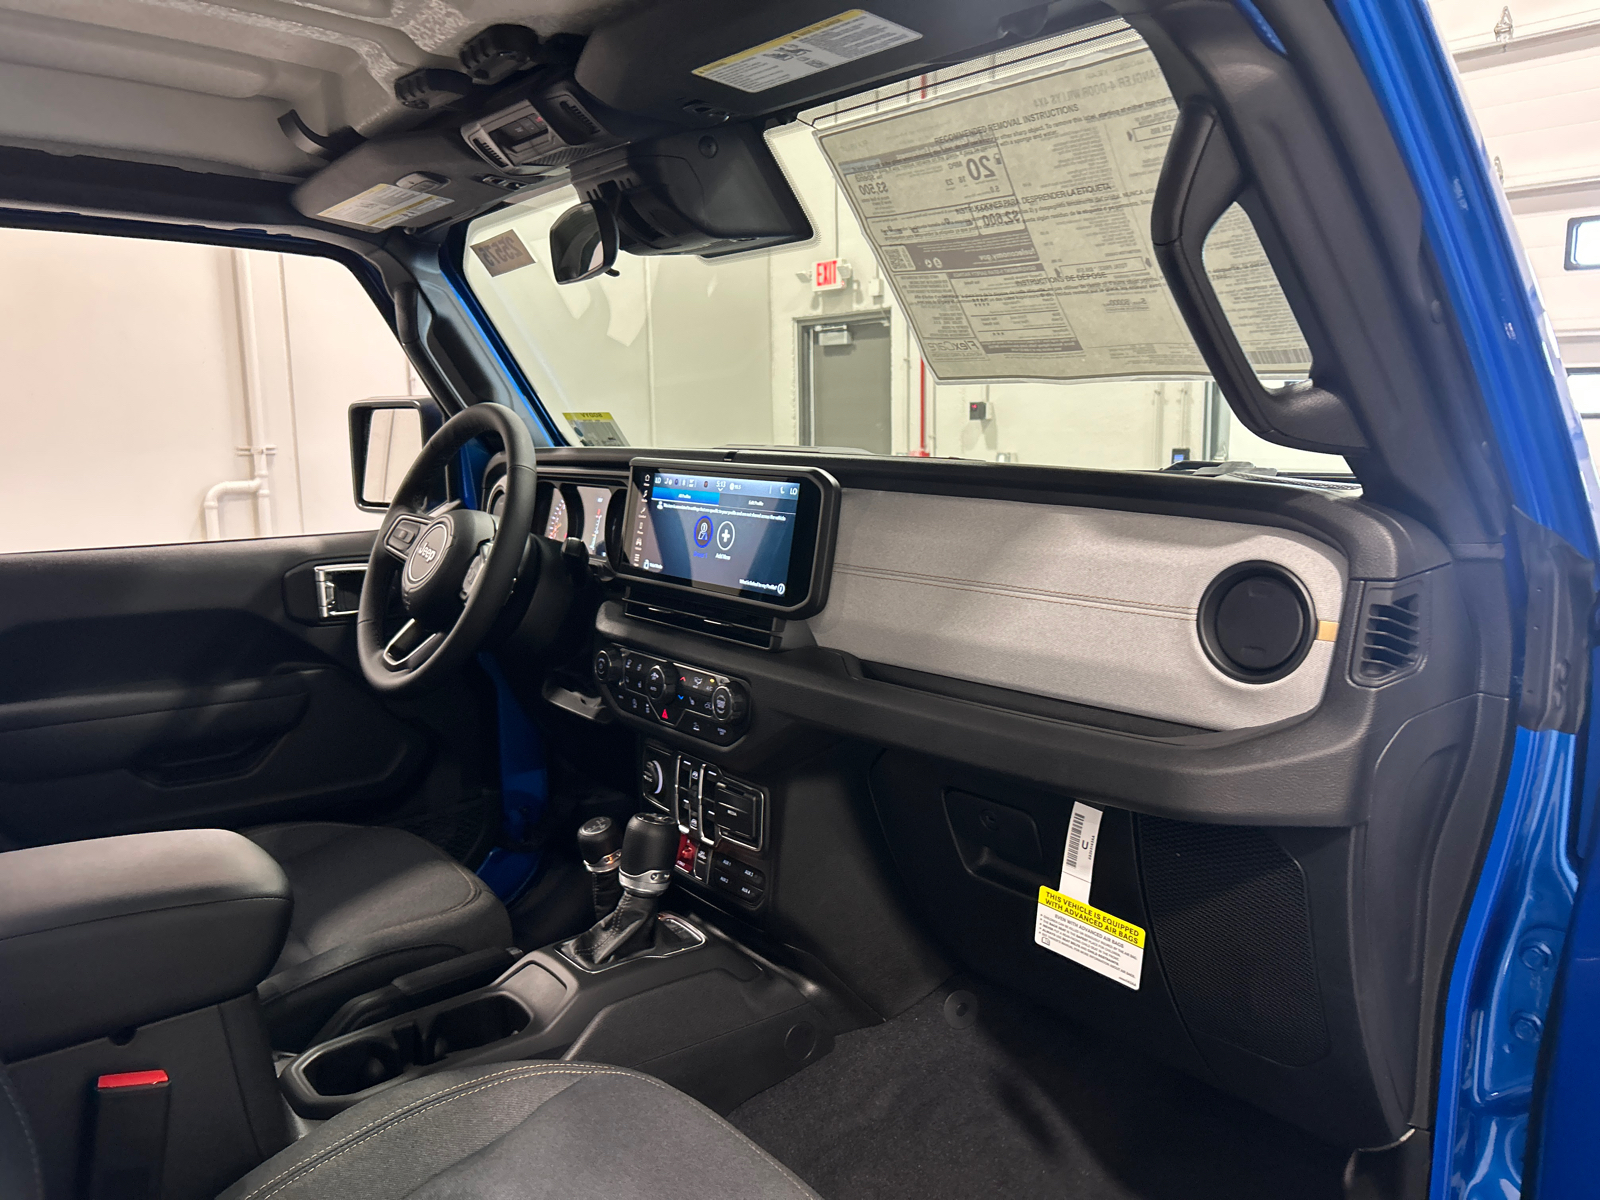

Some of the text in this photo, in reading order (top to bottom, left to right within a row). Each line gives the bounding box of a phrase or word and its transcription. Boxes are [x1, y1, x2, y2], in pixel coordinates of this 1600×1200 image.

[934, 103, 1079, 144] RECOMMENDED REMOVAL INSTRUCTIONS
[1021, 190, 1067, 204] DESPRENDER
[1067, 188, 1077, 198] LA
[1077, 183, 1112, 196] ETIQUETA
[816, 260, 838, 286] EXIT
[1016, 275, 1064, 287] INSTRUCTIONS
[1066, 274, 1076, 282] DE
[716, 480, 727, 488] 5:13
[790, 487, 798, 495] LO
[418, 542, 436, 564] Jeep
[1045, 898, 1138, 944] WITH ADVANCED AIR BAGS
[1046, 891, 1139, 936] THIS VEHICLE IS EQUIPPED
[1055, 914, 1066, 922] EVEN
[1067, 919, 1078, 927] WITH
[1079, 924, 1102, 939] ADVANCED
[1112, 938, 1124, 948] BAGS
